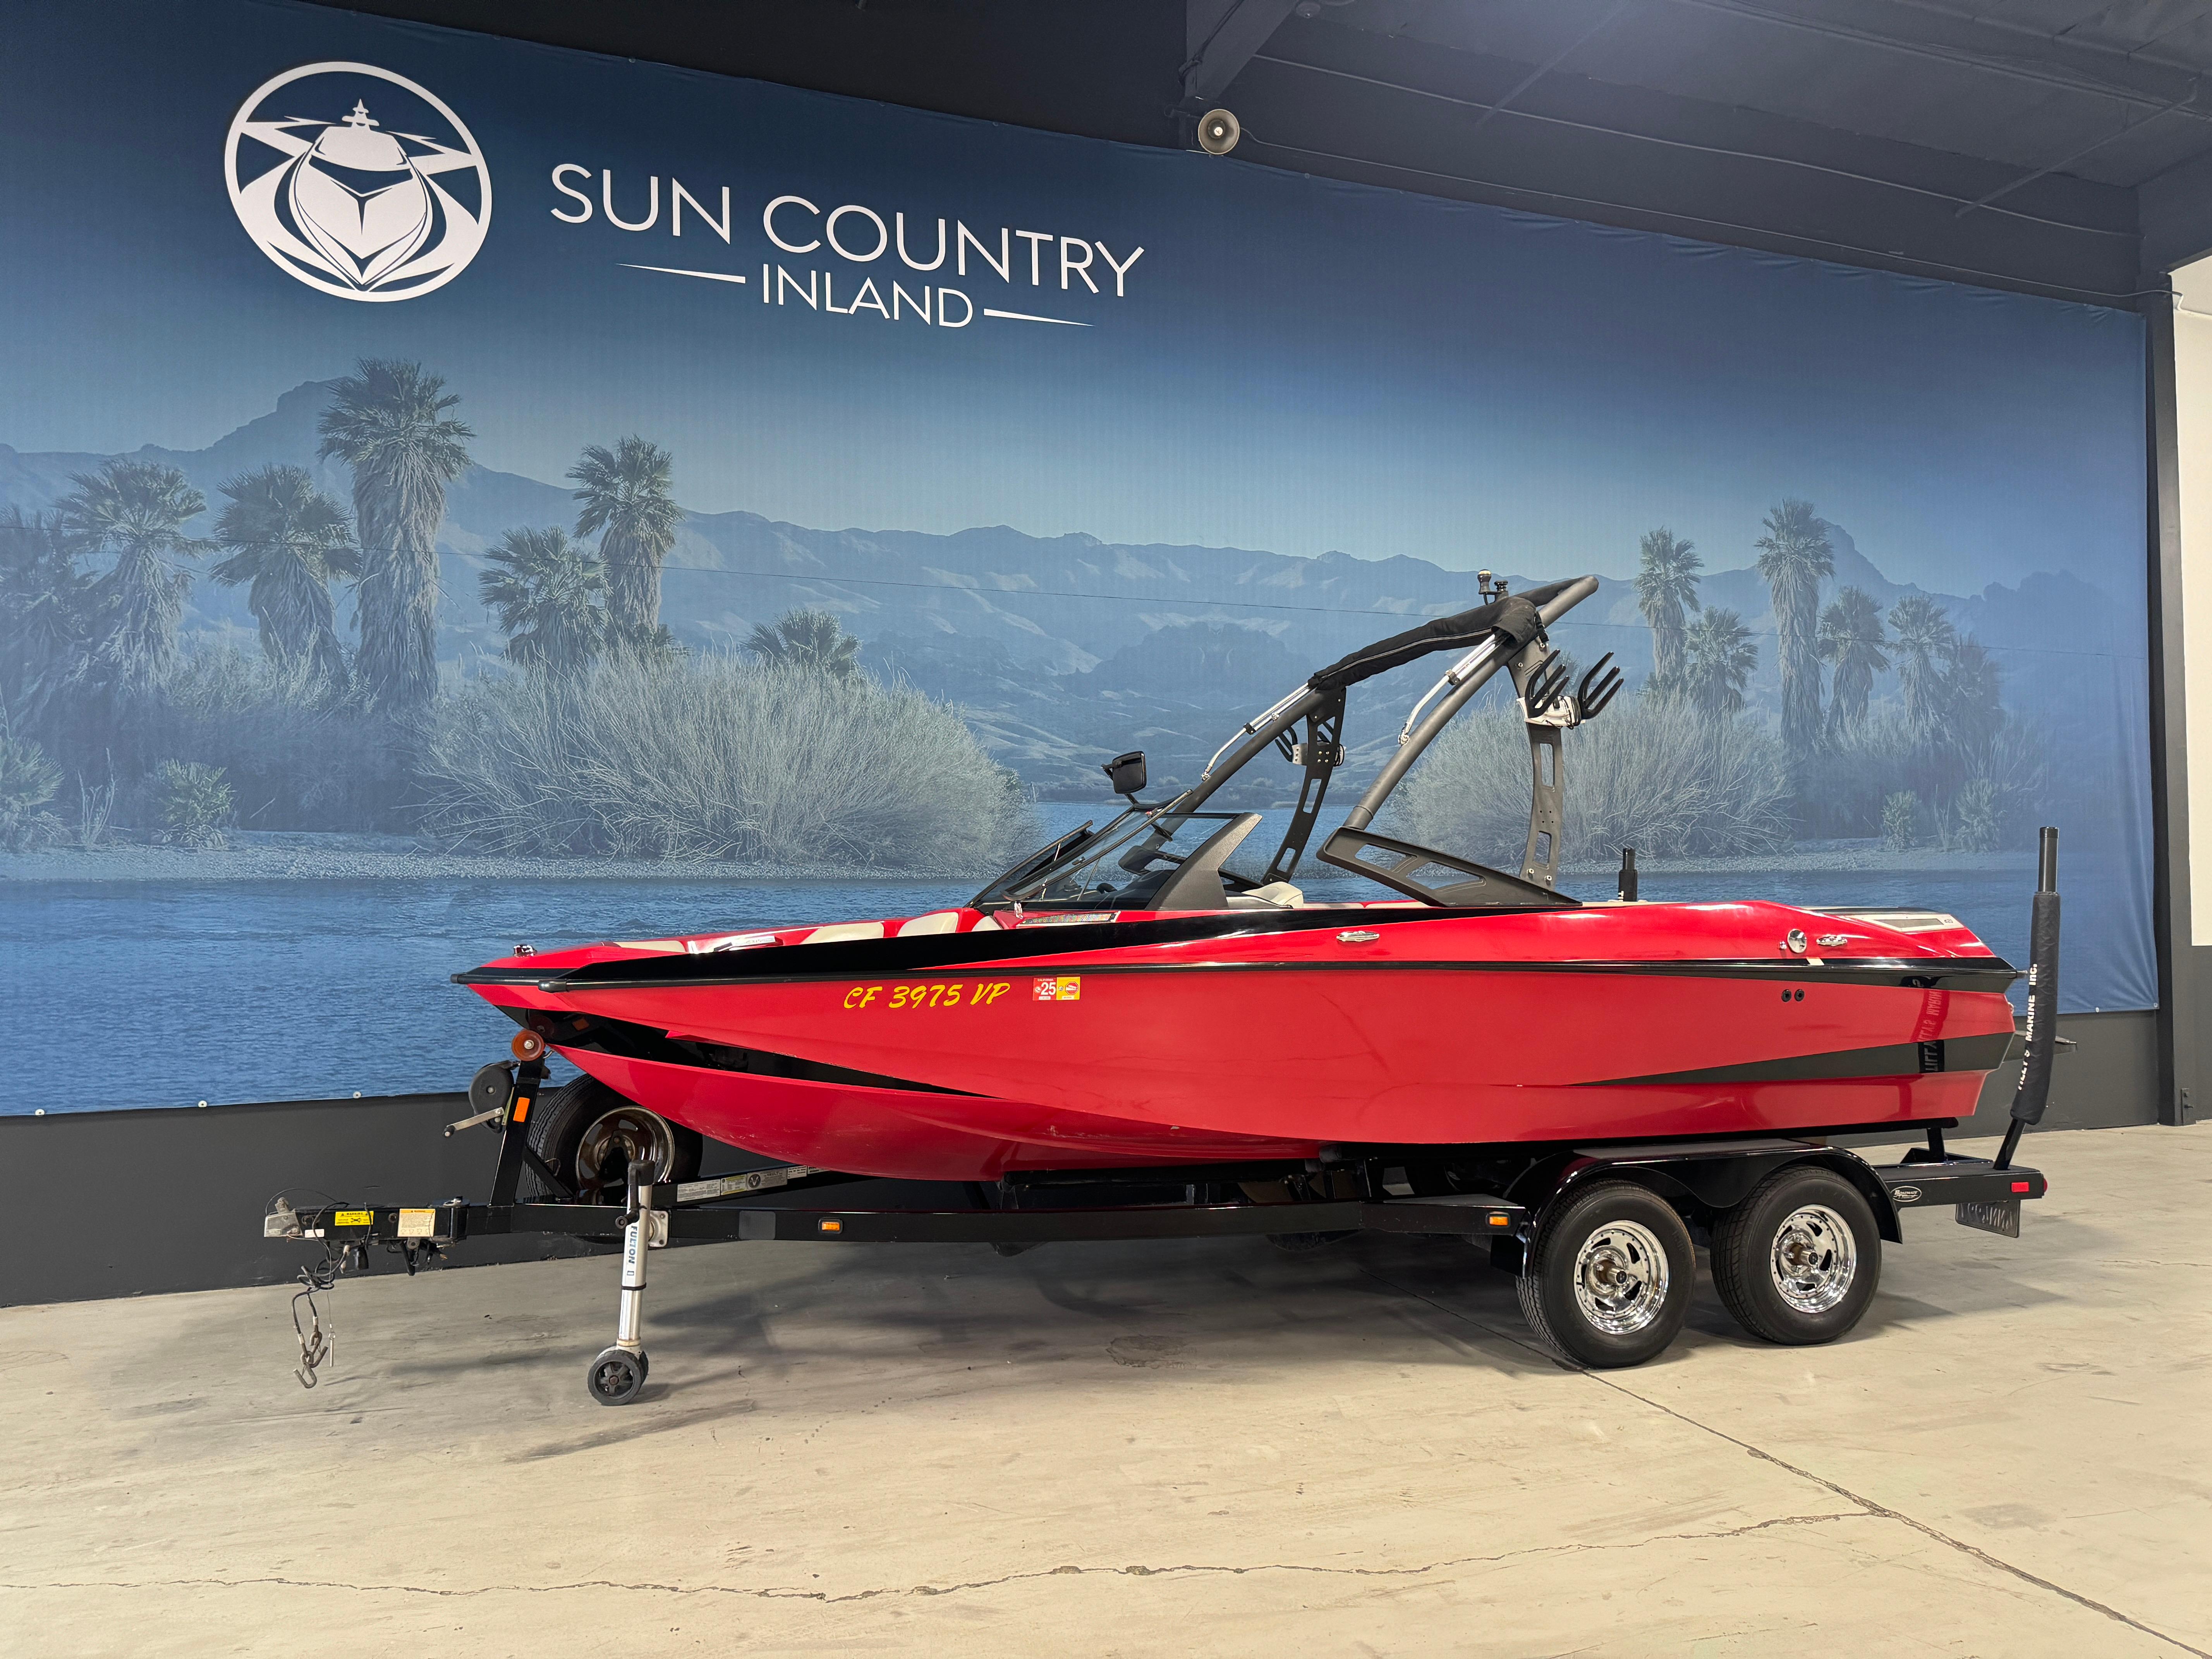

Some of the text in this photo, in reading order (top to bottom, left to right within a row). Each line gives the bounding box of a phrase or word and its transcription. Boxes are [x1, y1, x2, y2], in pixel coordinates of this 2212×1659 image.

[551, 163, 1145, 297] SUN COUNTRY
[763, 264, 973, 328] INLAND
[1041, 982, 1056, 995] 25
[2028, 963, 2038, 986] Inc.
[843, 982, 1011, 1009] CF 3975 VP
[628, 1225, 638, 1264] FULTON
